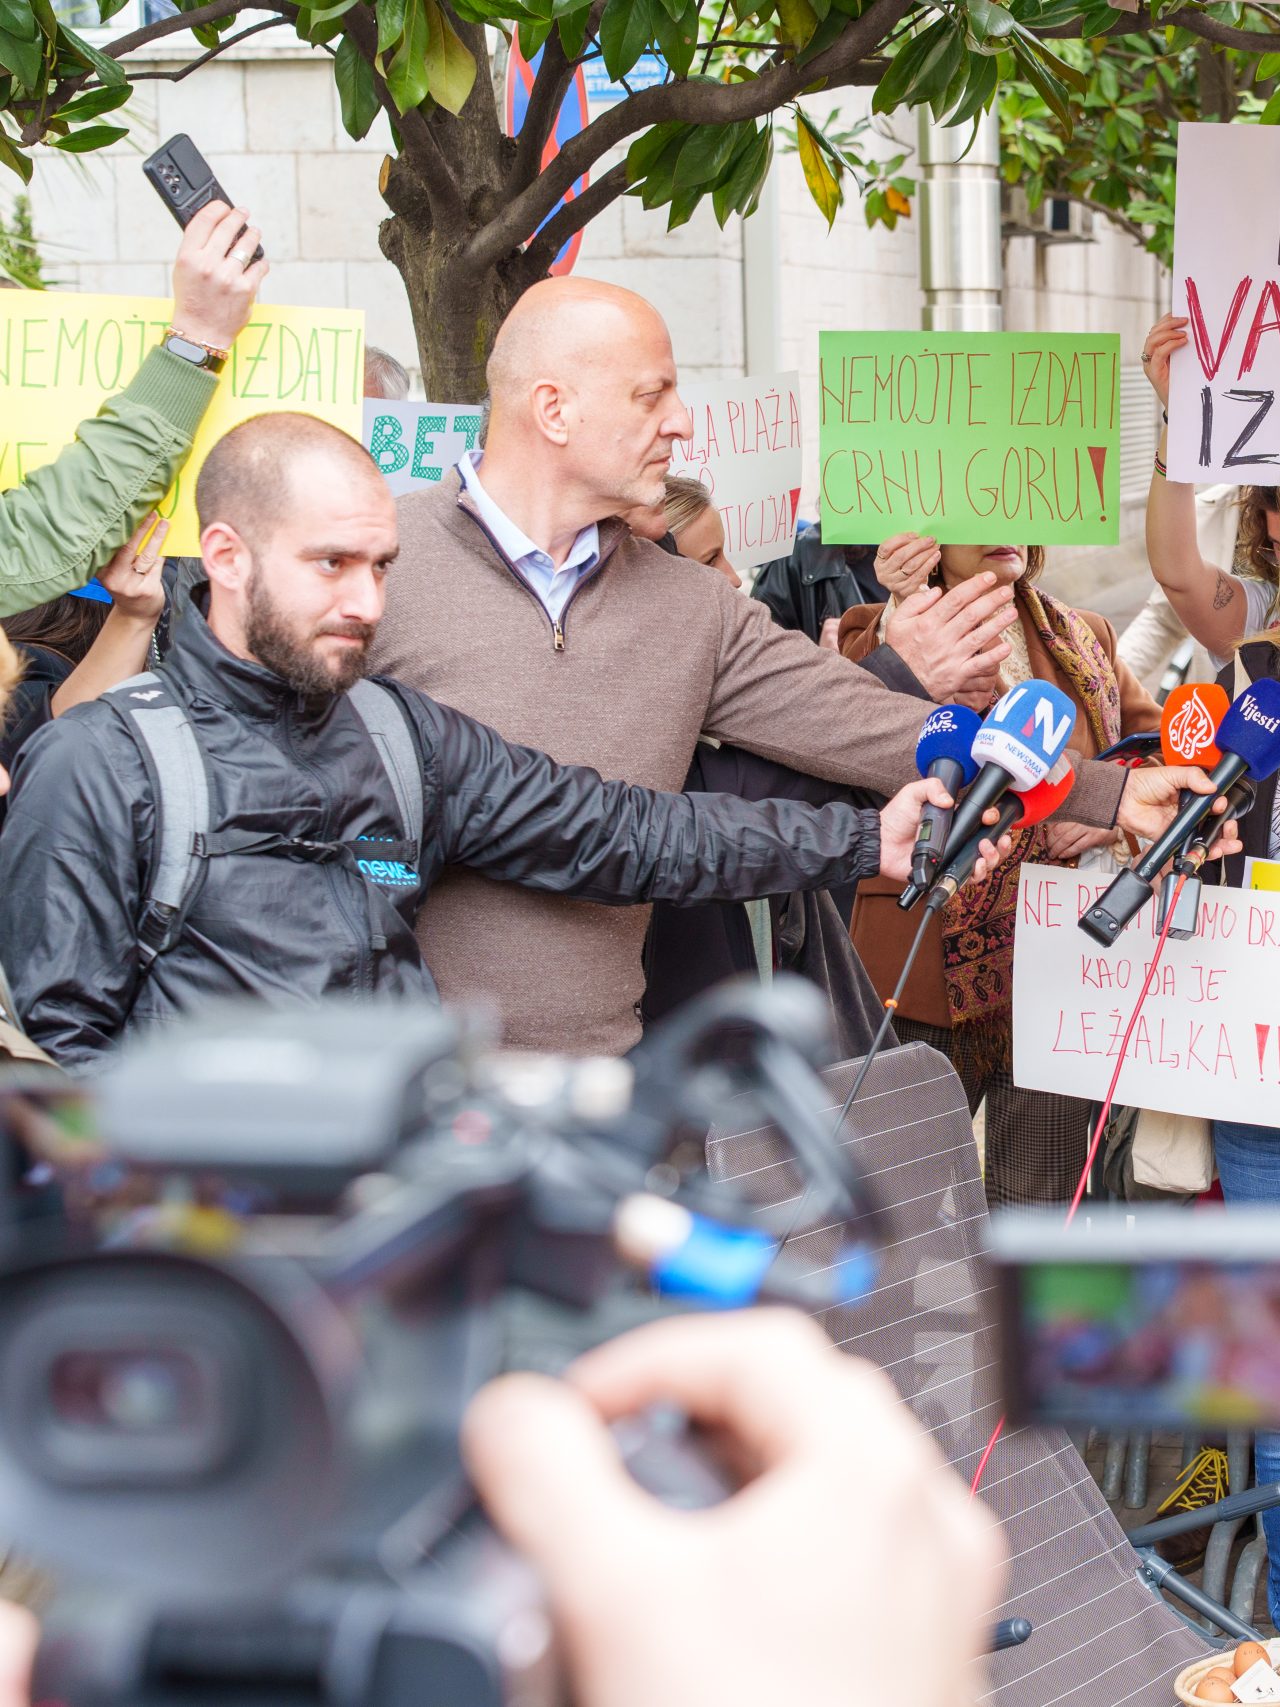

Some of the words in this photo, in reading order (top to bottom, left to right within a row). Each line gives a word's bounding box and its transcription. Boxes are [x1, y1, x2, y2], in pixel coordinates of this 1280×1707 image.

[230, 323, 363, 405] IZDATI
[819, 347, 991, 427] NEMOJTE
[1010, 350, 1117, 430] IZDATI
[726, 387, 801, 454] PLAŽA
[822, 446, 946, 518] CRNU
[965, 445, 1108, 523] GORU!
[1239, 693, 1280, 734] Vijesti
[1005, 741, 1043, 777] NEWSMAX
[1023, 879, 1063, 928] NE
[1081, 954, 1132, 989] KAO
[1144, 961, 1176, 997] DA
[1186, 959, 1228, 1003] JE
